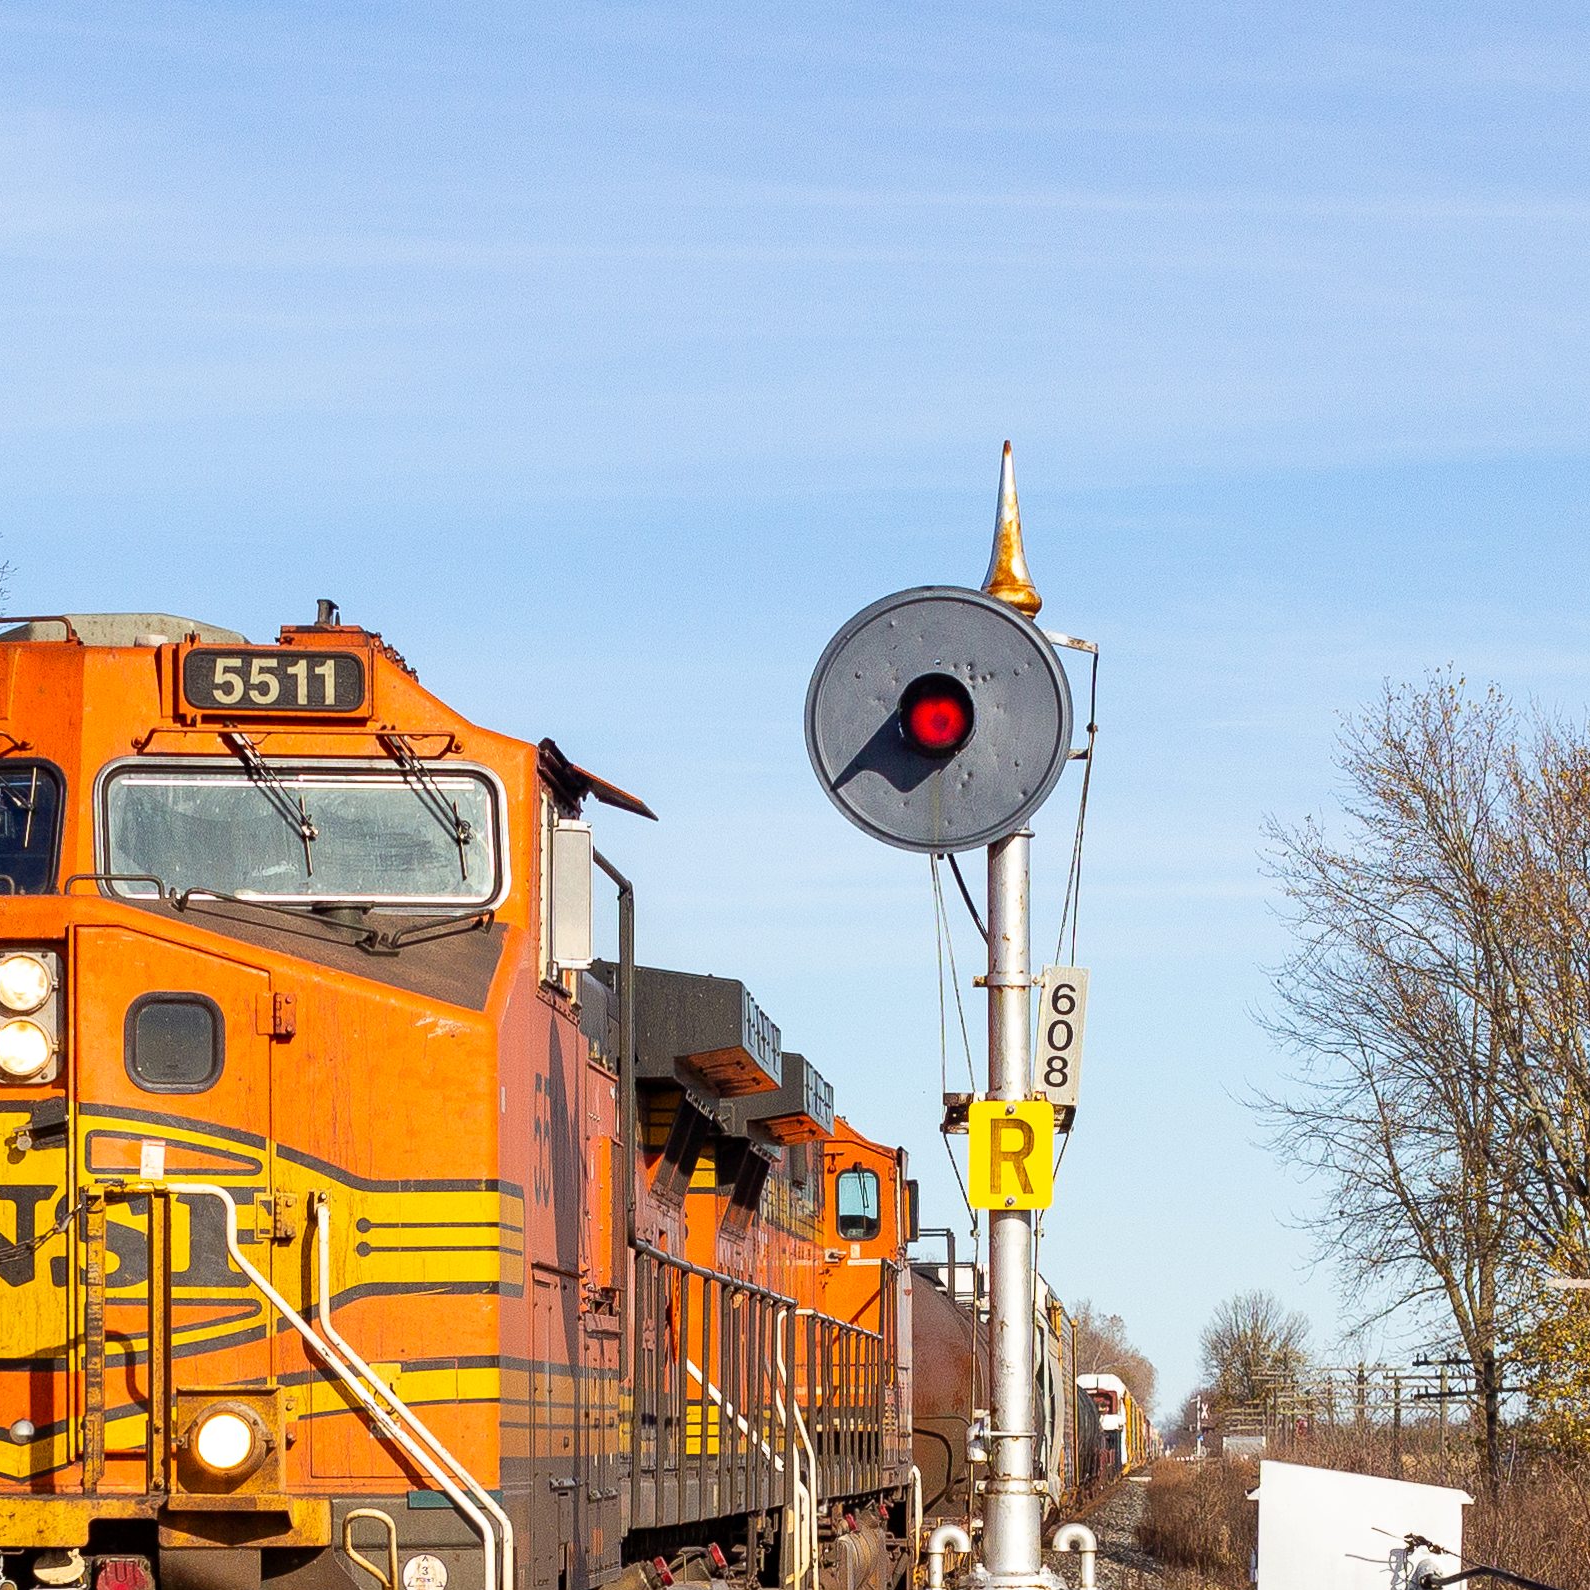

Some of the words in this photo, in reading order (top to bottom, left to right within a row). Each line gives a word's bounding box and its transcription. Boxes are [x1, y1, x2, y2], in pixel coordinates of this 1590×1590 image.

[212, 658, 336, 706] 5511
[1043, 983, 1077, 1088] 608
[989, 1118, 1035, 1195] R
